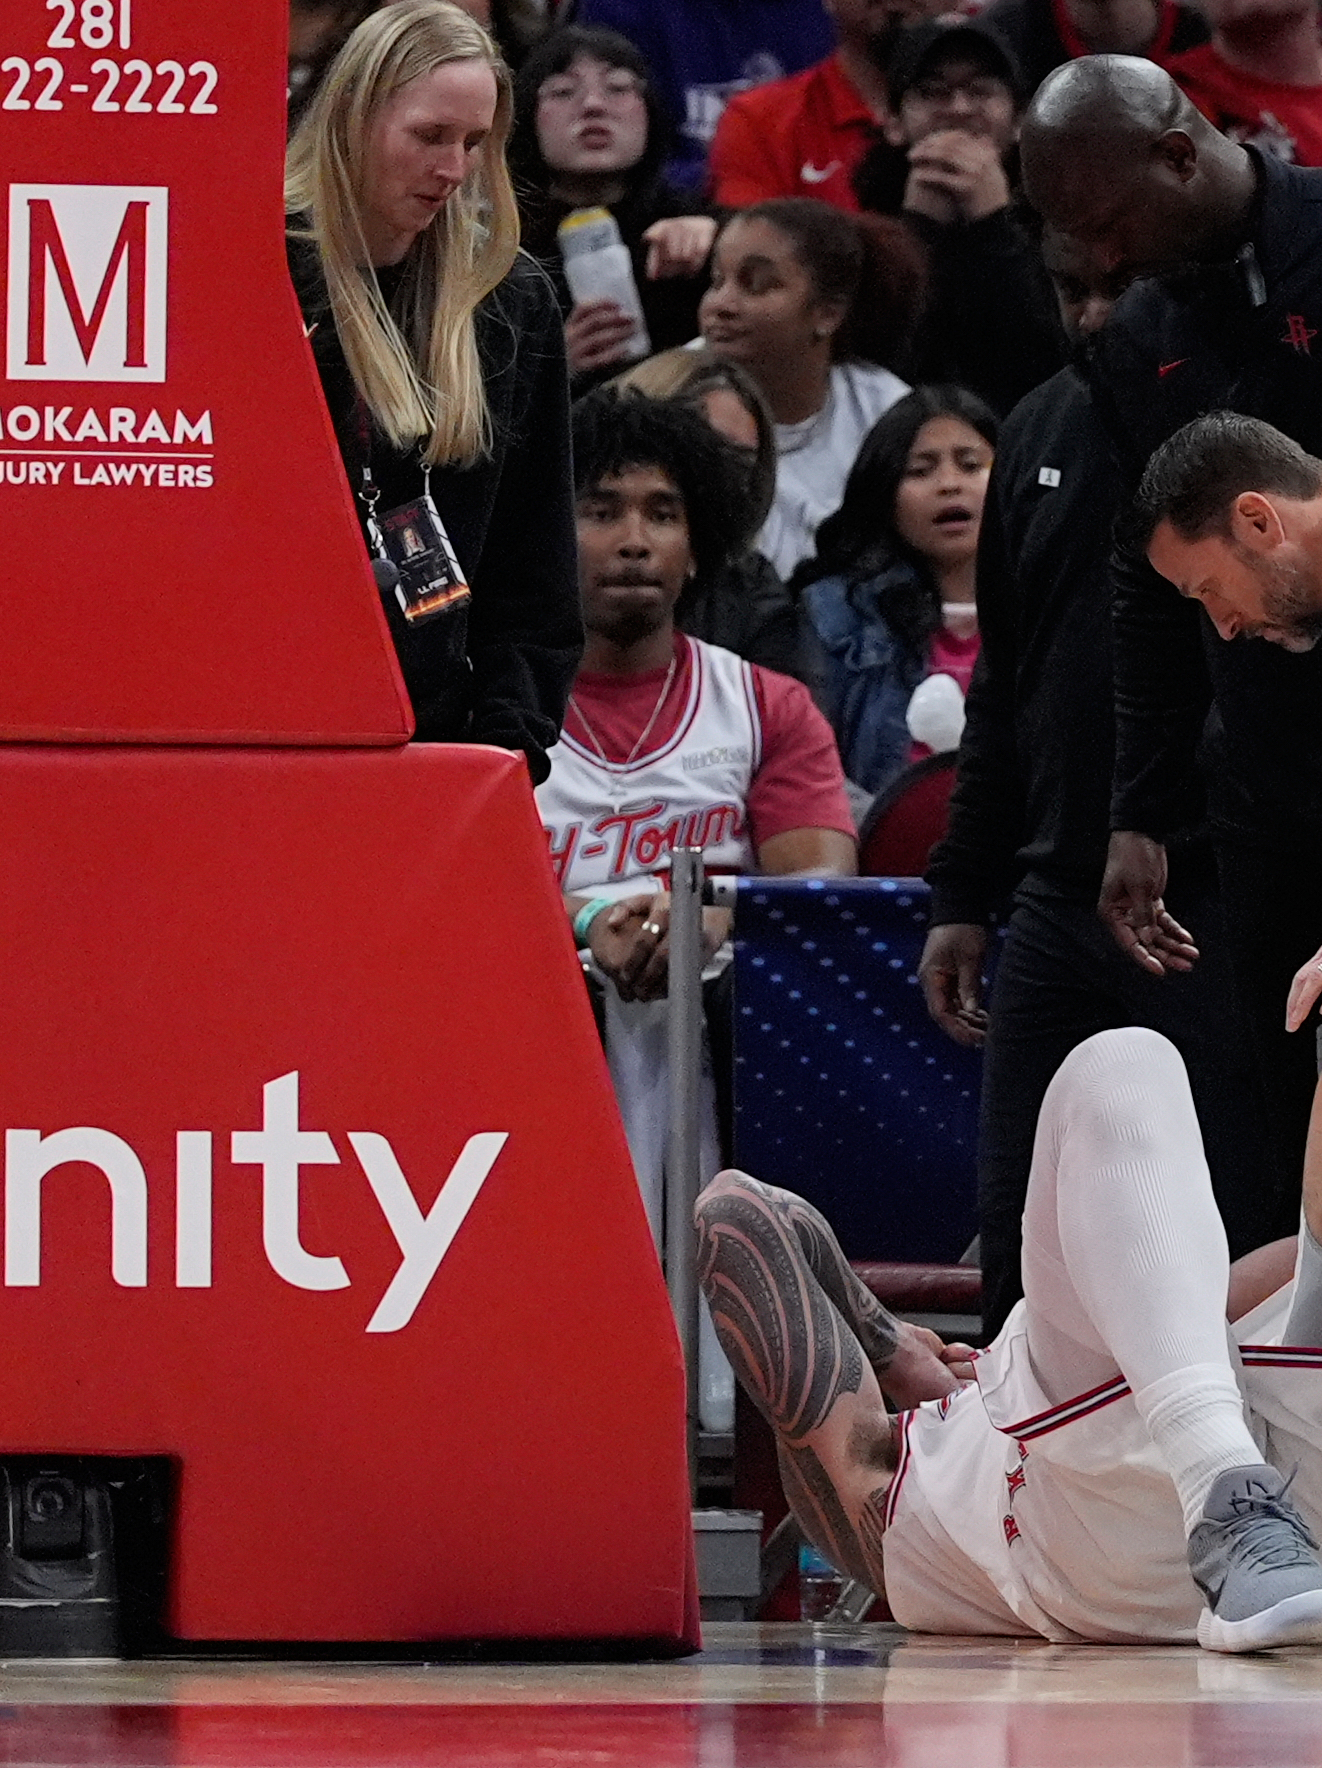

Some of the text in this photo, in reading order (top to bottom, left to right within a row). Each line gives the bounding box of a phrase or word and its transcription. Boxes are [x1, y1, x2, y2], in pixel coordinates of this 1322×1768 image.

[46, 0, 131, 49] 281
[1, 56, 218, 114] 22-2222
[0, 405, 214, 445] OKARAM
[73, 462, 214, 488] LAWYERS
